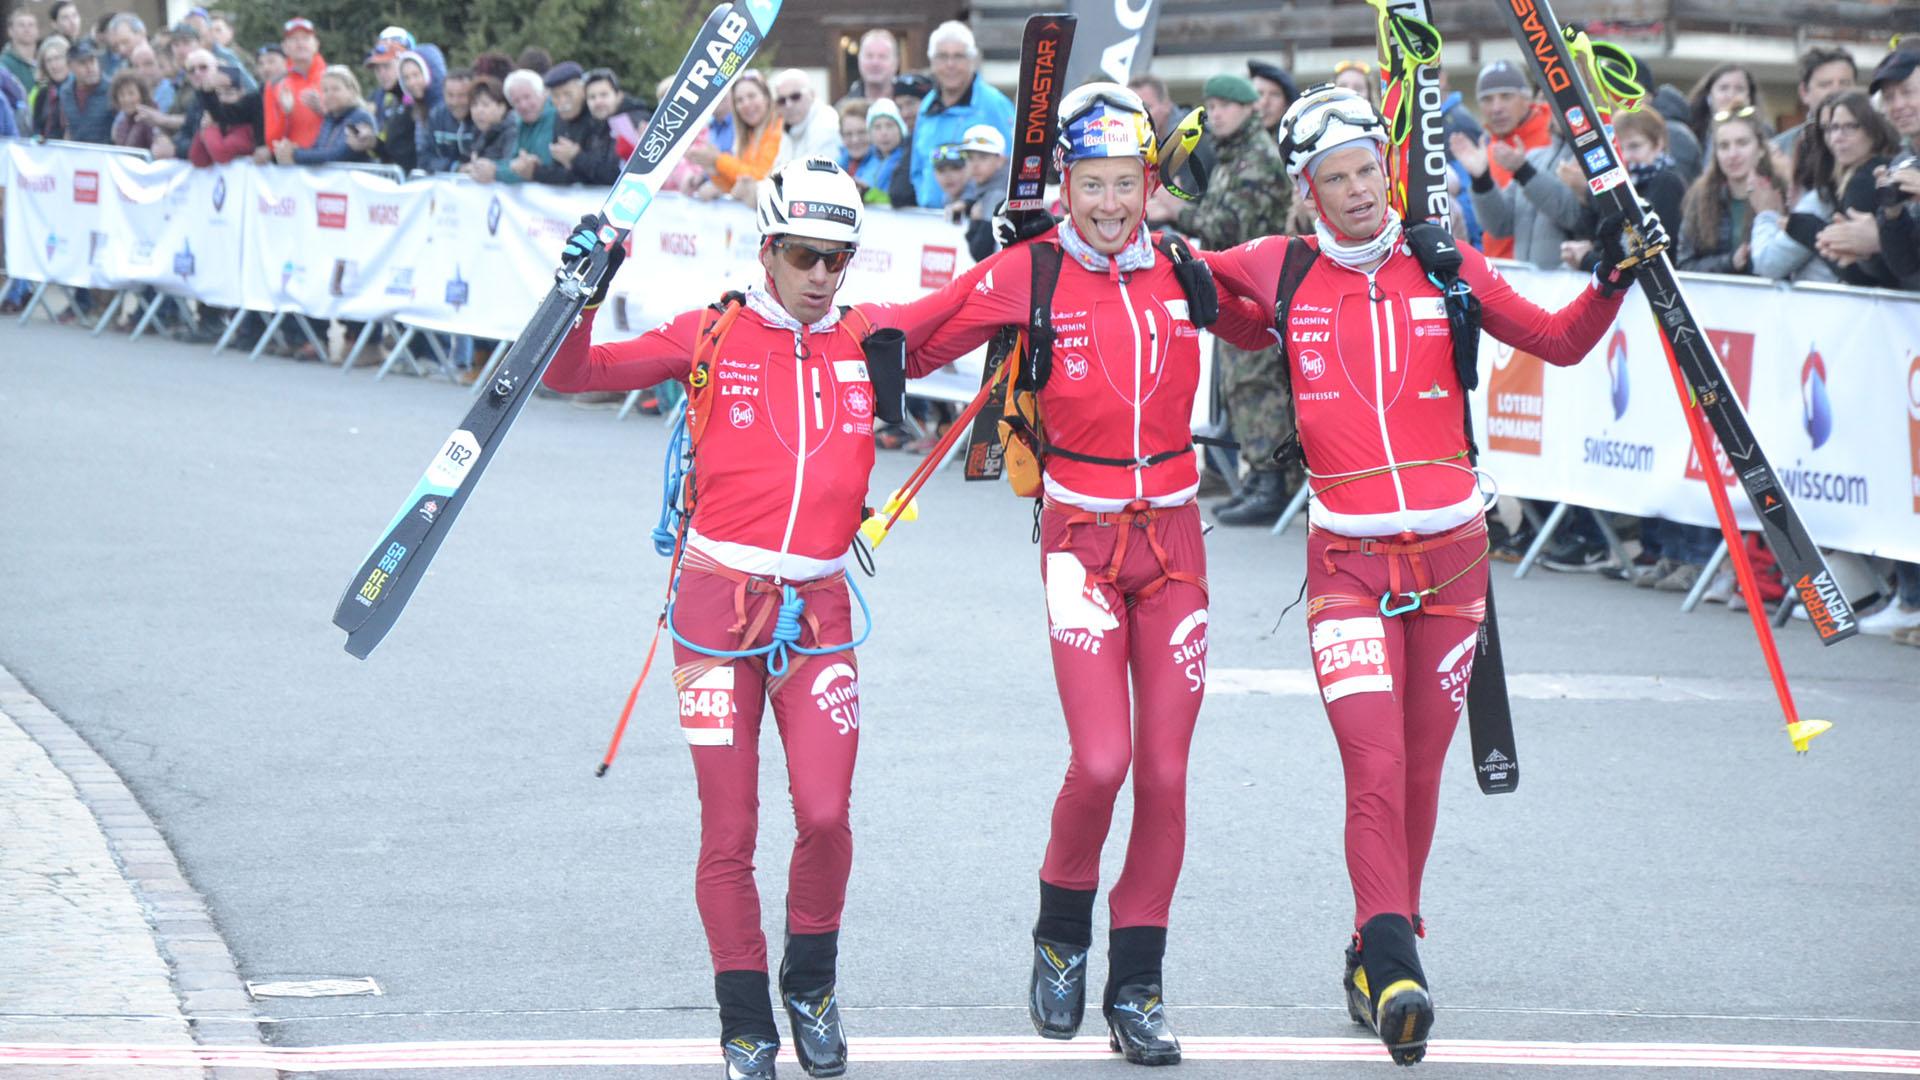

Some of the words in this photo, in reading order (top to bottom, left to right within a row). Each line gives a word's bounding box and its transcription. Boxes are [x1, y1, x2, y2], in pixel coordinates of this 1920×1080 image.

[1026, 39, 1058, 145] DYNASTAR
[809, 203, 855, 219] BAYARD
[1292, 317, 1329, 325] GARMIN
[1053, 336, 1089, 348] LEKI
[1292, 331, 1330, 342] LEKI
[719, 371, 758, 382] GARMIN
[721, 385, 759, 396] LEKI
[1497, 392, 1542, 416] LOTERIE
[1490, 416, 1542, 442] ROMANDE
[444, 440, 472, 467] 162
[1583, 429, 1654, 472] swisscom
[1796, 575, 1839, 638] PIERRA
[1812, 570, 1855, 632] MENTA
[1319, 639, 1385, 676] 2548
[1377, 665, 1384, 675] 3
[680, 690, 730, 717] 2548
[831, 702, 858, 735] SU
[1479, 761, 1516, 773] MINIM
